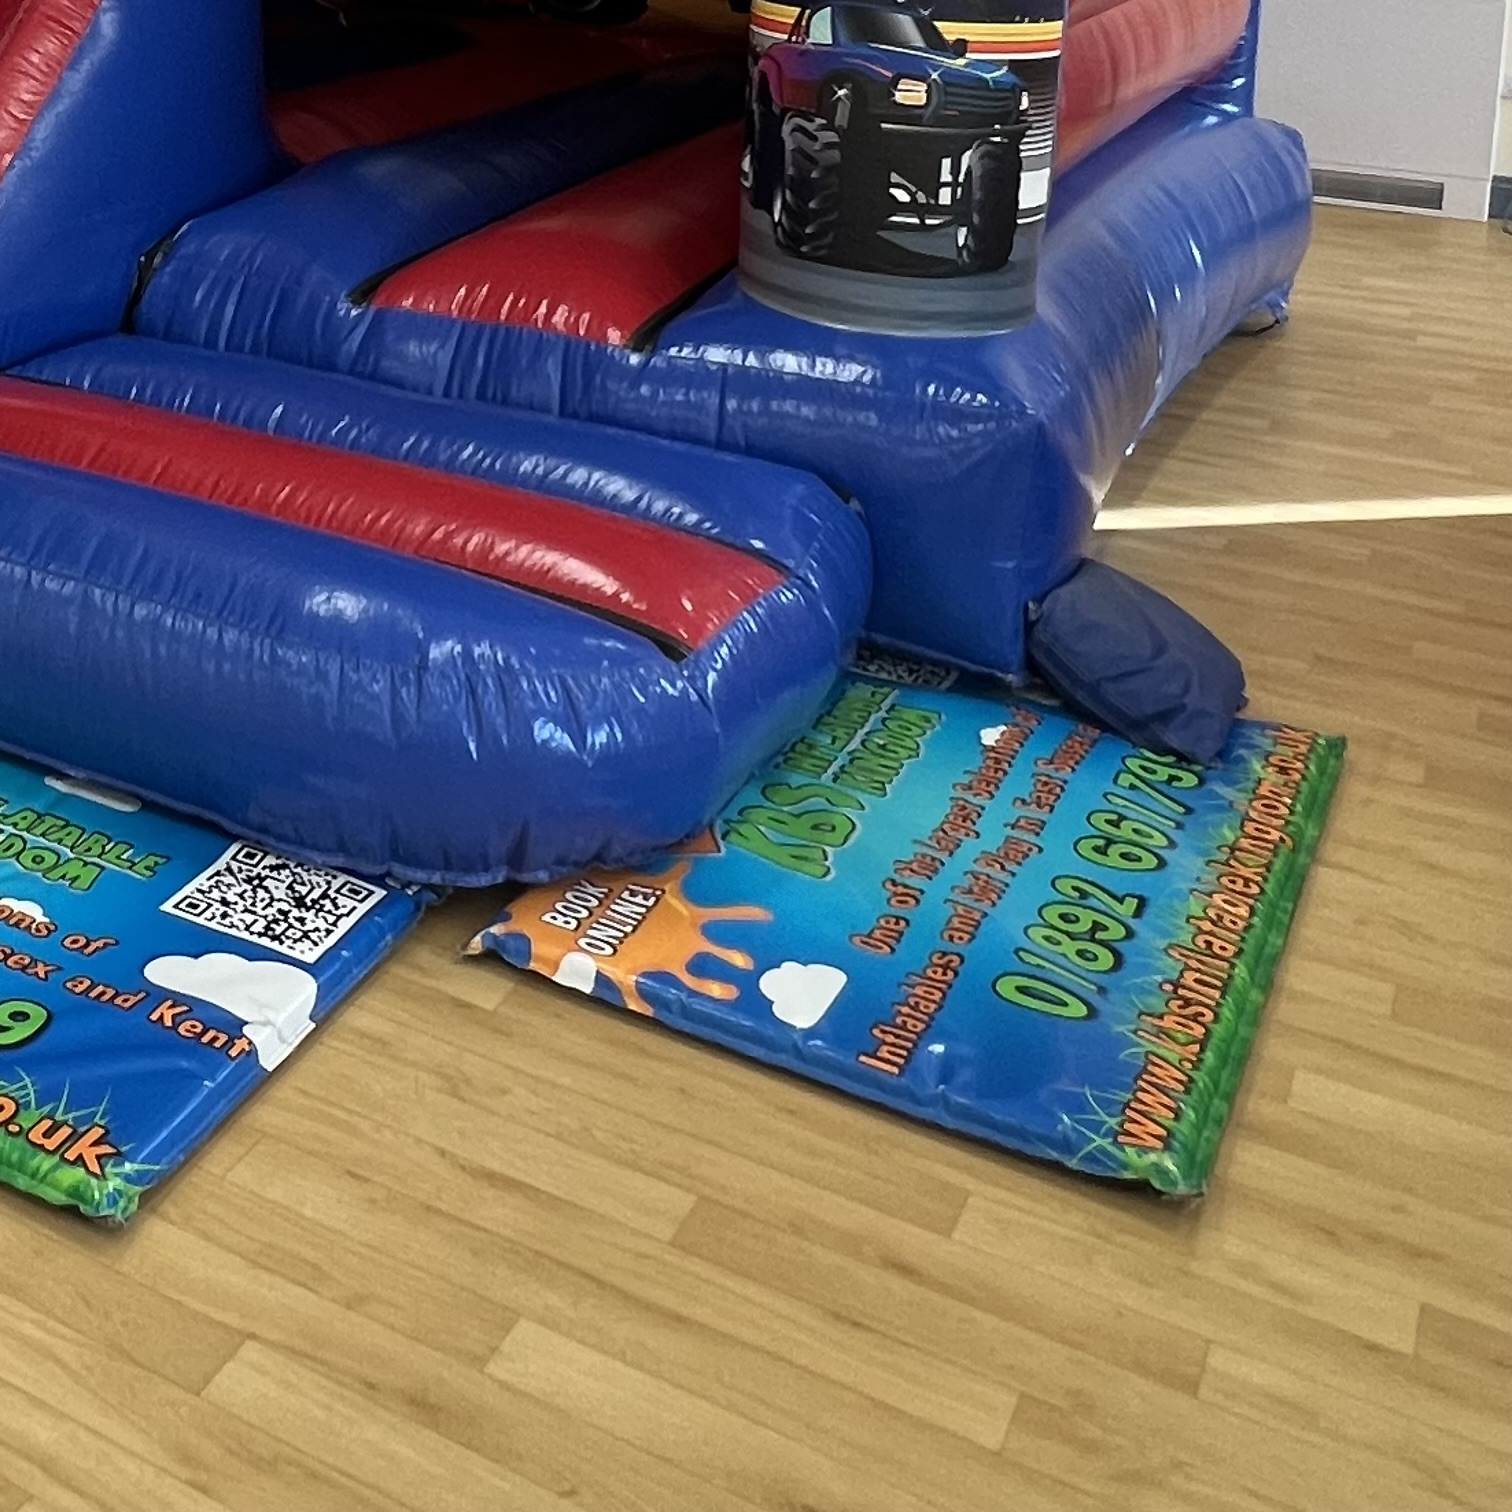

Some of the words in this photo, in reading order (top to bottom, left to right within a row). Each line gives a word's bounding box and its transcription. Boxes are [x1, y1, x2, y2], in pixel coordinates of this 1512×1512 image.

[832, 703, 942, 798] KINGDOM
[952, 723, 1035, 801] Selections
[1012, 772, 1069, 814] East
[720, 782, 866, 880] KBS
[911, 796, 986, 857] Largest
[1003, 815, 1047, 837] in
[893, 852, 945, 881] the
[973, 835, 1044, 878] Play
[540, 879, 612, 931] BOOK
[882, 877, 925, 909] of
[951, 871, 1010, 907] Soft
[62, 932, 118, 957] of
[576, 883, 665, 956] ONLINE!
[848, 914, 910, 955] One
[940, 898, 989, 945] and
[1114, 723, 1317, 1150] www.kbsinflatablekingdom.co.uk
[992, 875, 1146, 1020] 01892
[65, 975, 146, 1010] and
[148, 999, 253, 1060] Kent
[858, 951, 965, 1077] Inflatables
